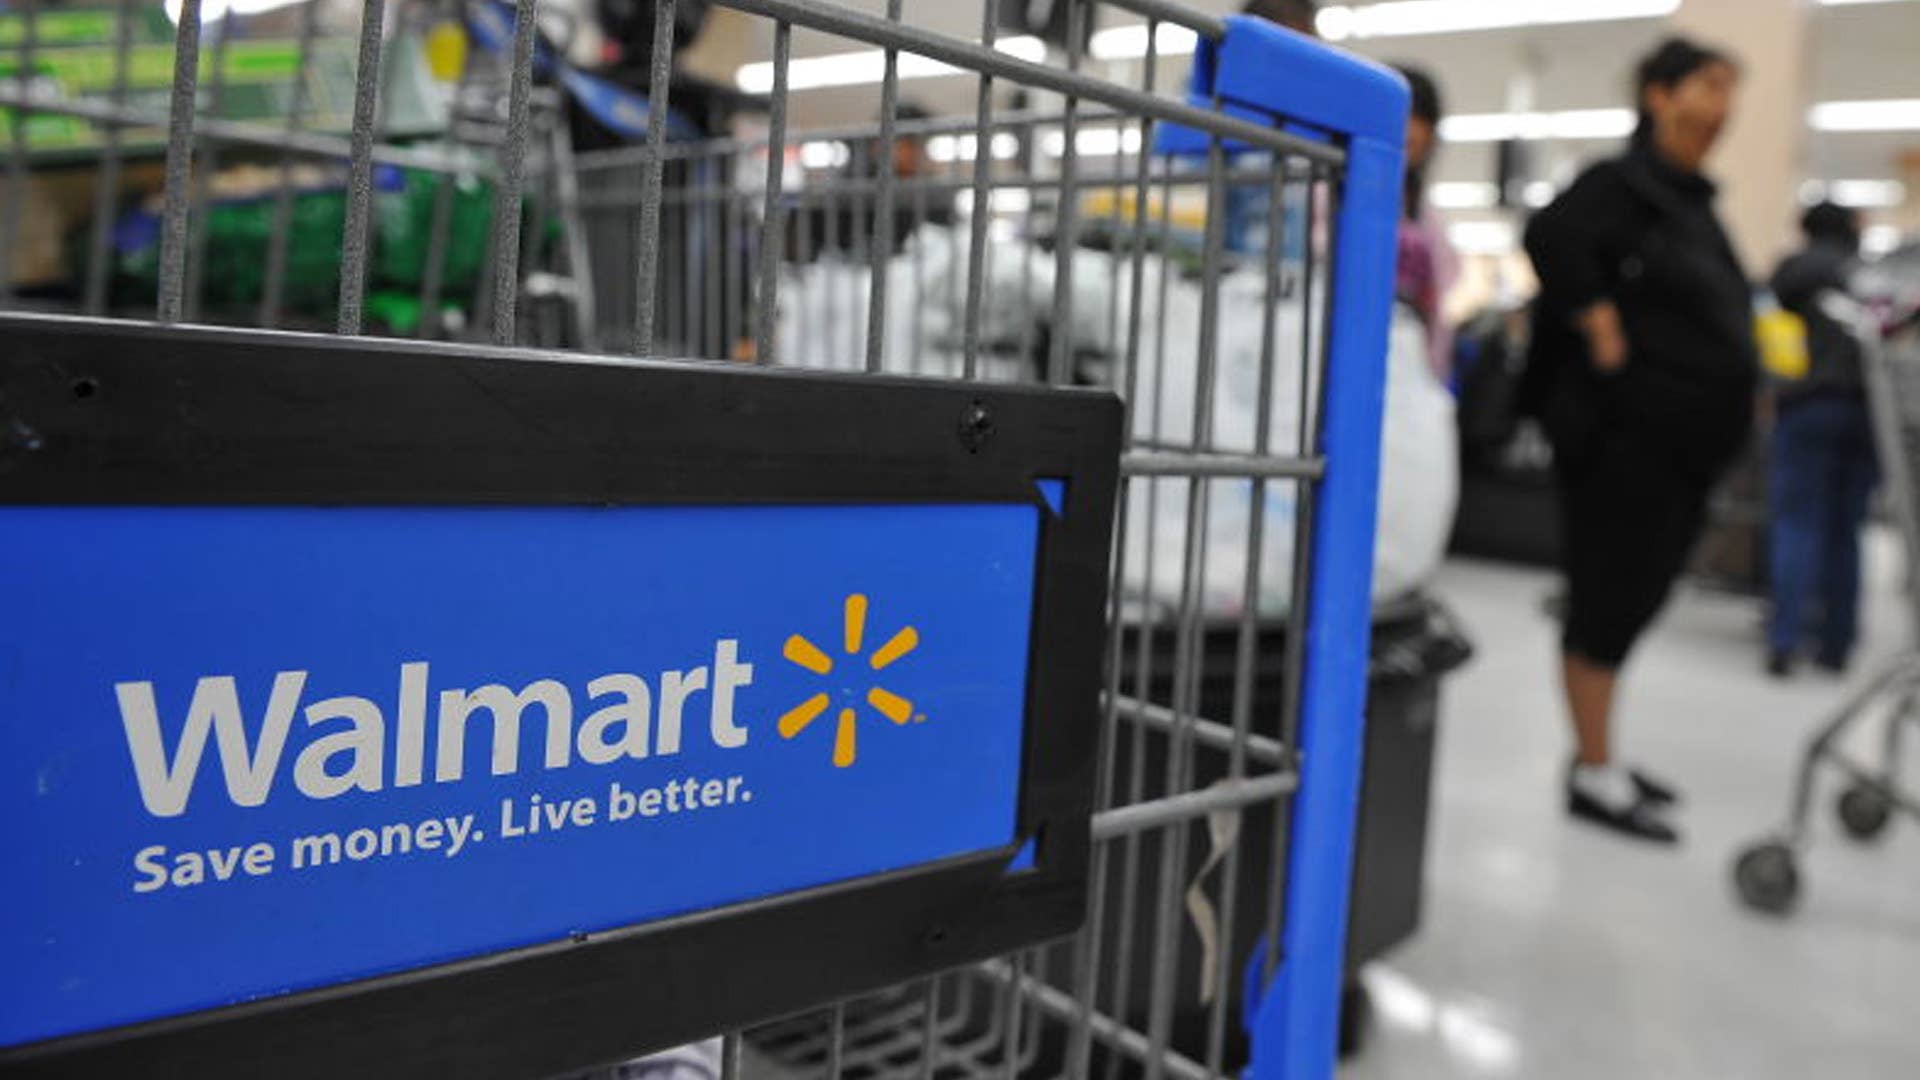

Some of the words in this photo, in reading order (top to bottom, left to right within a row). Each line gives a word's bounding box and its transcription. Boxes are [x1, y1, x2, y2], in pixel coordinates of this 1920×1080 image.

[115, 638, 753, 817] Walmart
[133, 842, 276, 893] Save
[292, 813, 485, 869] money.
[501, 792, 597, 838] Live
[609, 775, 752, 821] better.
